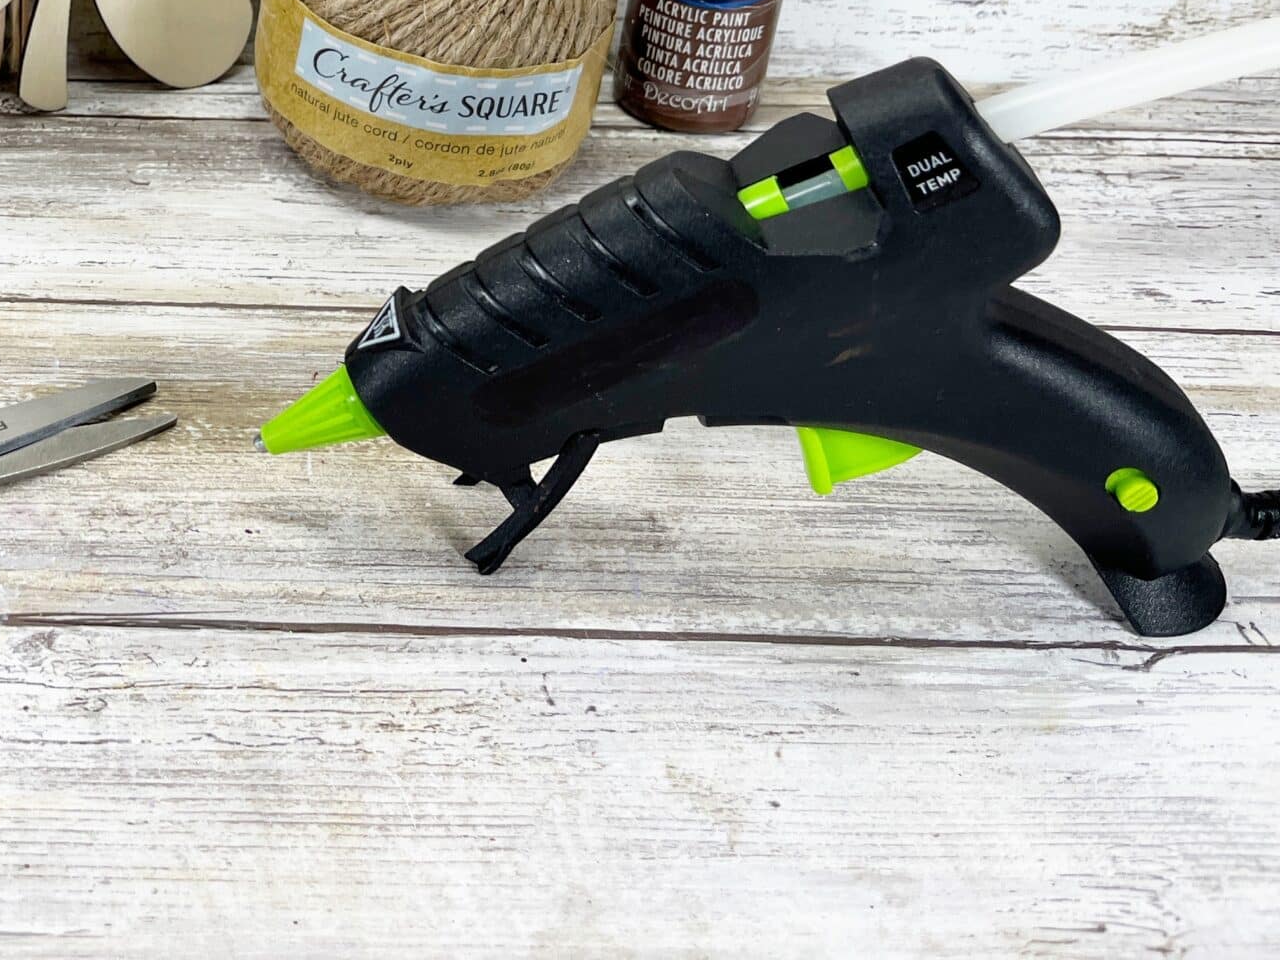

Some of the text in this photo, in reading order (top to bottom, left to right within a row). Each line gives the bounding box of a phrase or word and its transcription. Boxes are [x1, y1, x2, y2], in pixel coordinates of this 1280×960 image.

[639, 3, 766, 44] PEINTURE ACRYLIQUE
[712, 11, 752, 27] PAINT
[641, 24, 692, 55] PINTURA
[645, 44, 679, 68] TINTA
[312, 47, 564, 121] Crafter's SQUARE
[637, 57, 683, 86] COLORE
[685, 74, 744, 91] ACRILICO
[290, 82, 331, 114] natural
[332, 108, 360, 129] jute
[363, 123, 399, 142] cord
[414, 139, 471, 155] cordon
[475, 143, 495, 156] de
[499, 143, 527, 158] jute
[388, 153, 414, 169] 2ply
[906, 151, 953, 178] DUAL
[915, 168, 961, 195] TEMP
